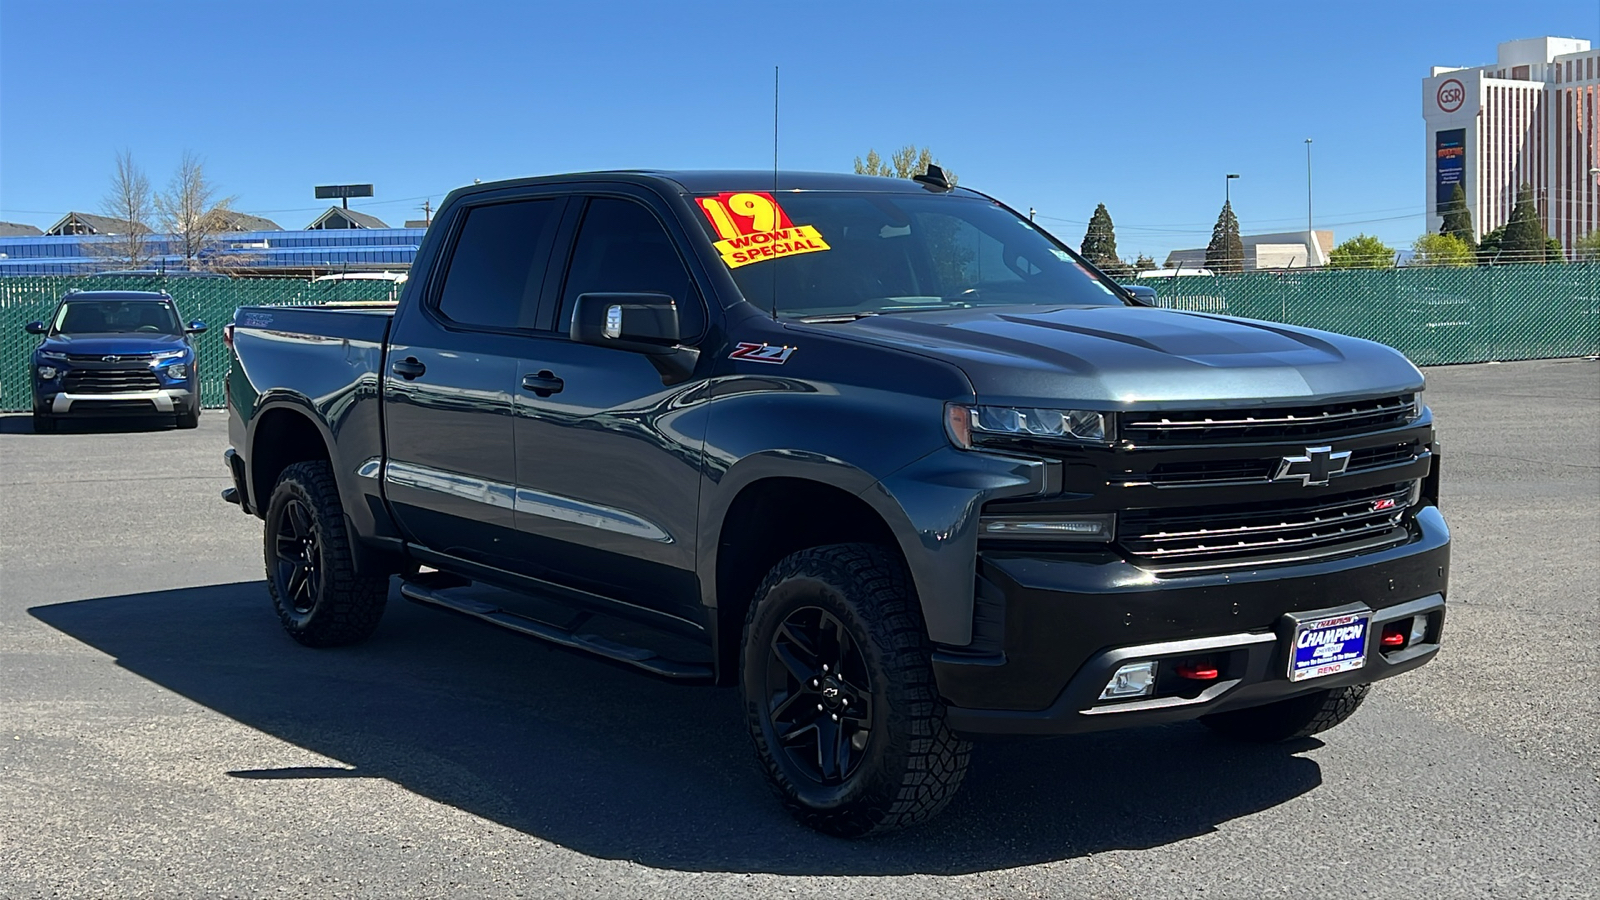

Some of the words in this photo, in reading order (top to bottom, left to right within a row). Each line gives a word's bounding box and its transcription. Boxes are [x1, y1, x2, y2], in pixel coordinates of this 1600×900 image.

[1440, 89, 1461, 103] GSR
[702, 193, 780, 239] 19
[732, 239, 821, 263] SPECIAL
[728, 342, 797, 365] Z71
[1316, 616, 1353, 628] CHAMPION
[1297, 624, 1364, 649] CHAMPION
[1316, 645, 1342, 655] CHEVROLET
[1317, 664, 1341, 675] RENO
